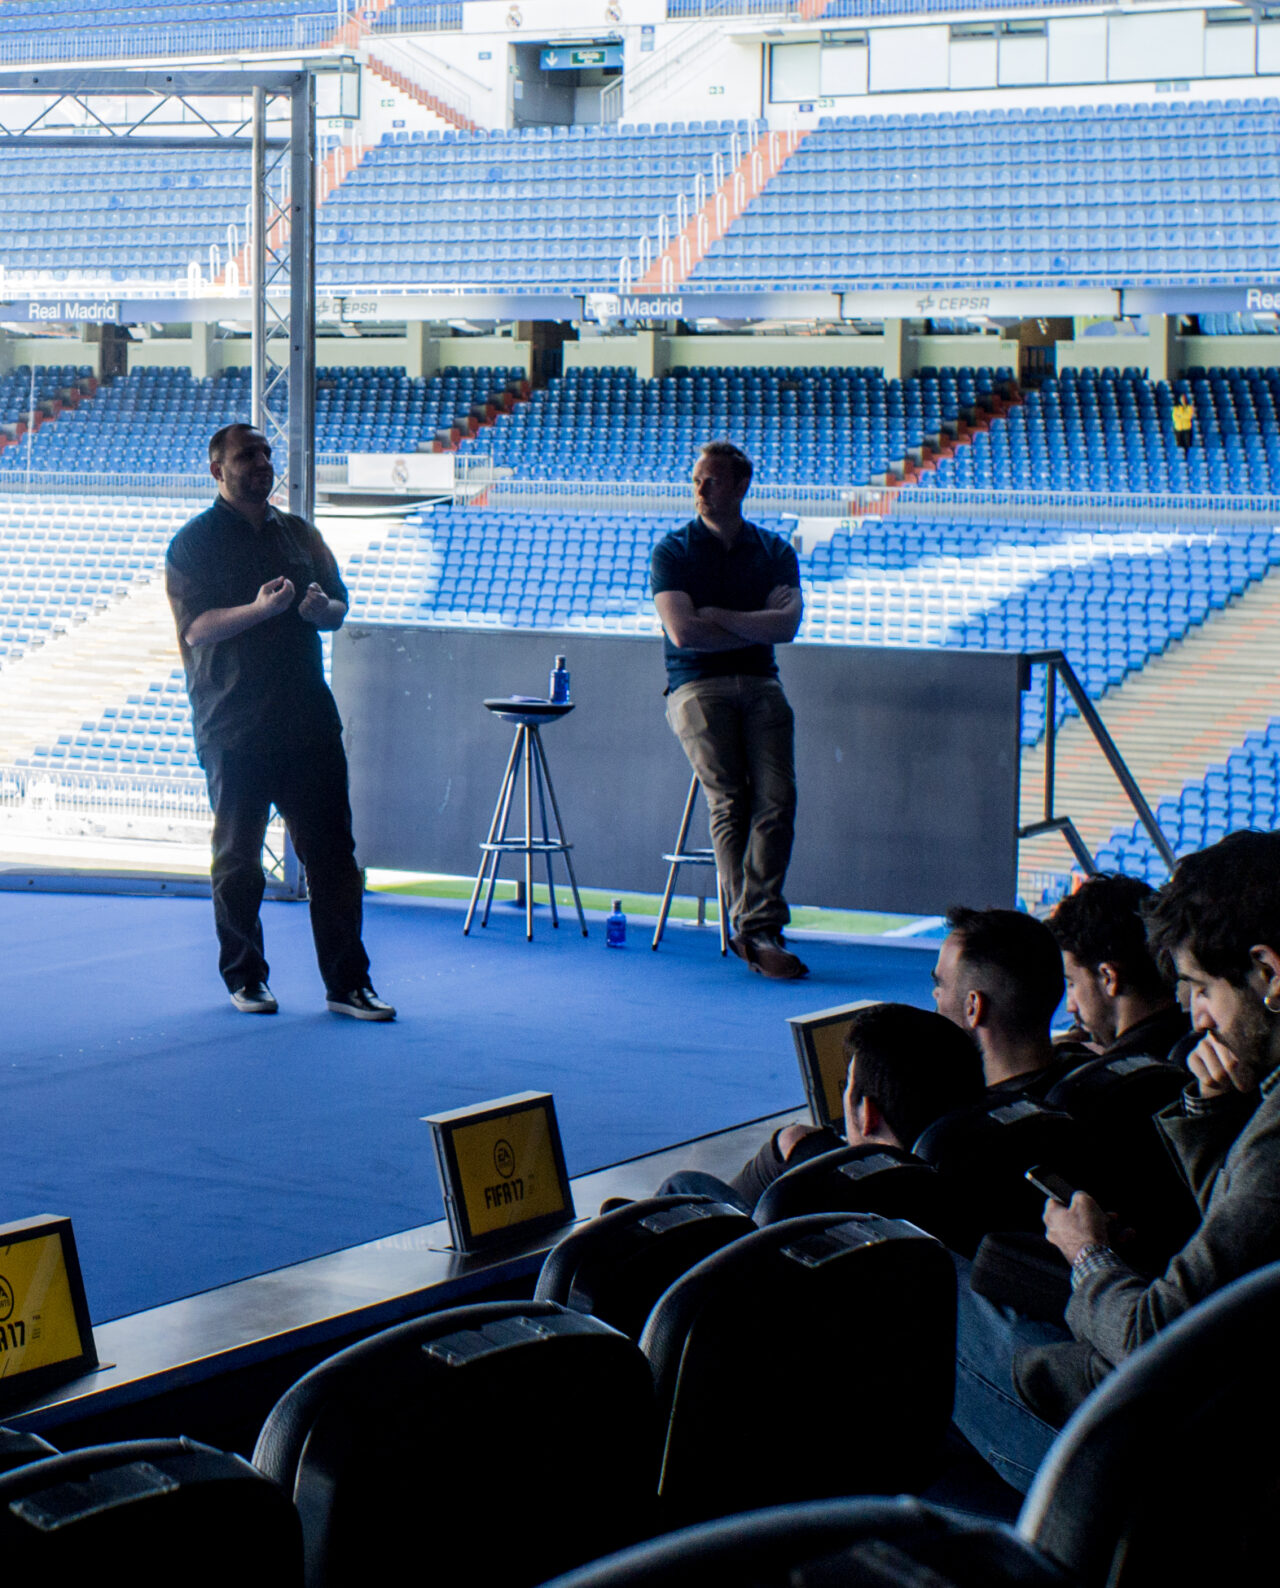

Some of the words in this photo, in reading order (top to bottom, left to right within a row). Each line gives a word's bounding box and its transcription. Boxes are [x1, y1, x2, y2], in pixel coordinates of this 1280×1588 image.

[28, 303, 60, 319] Real
[65, 302, 116, 319] Madrid
[585, 298, 620, 316] Ral
[623, 298, 682, 316] Madrid
[939, 296, 990, 310] CEPSA
